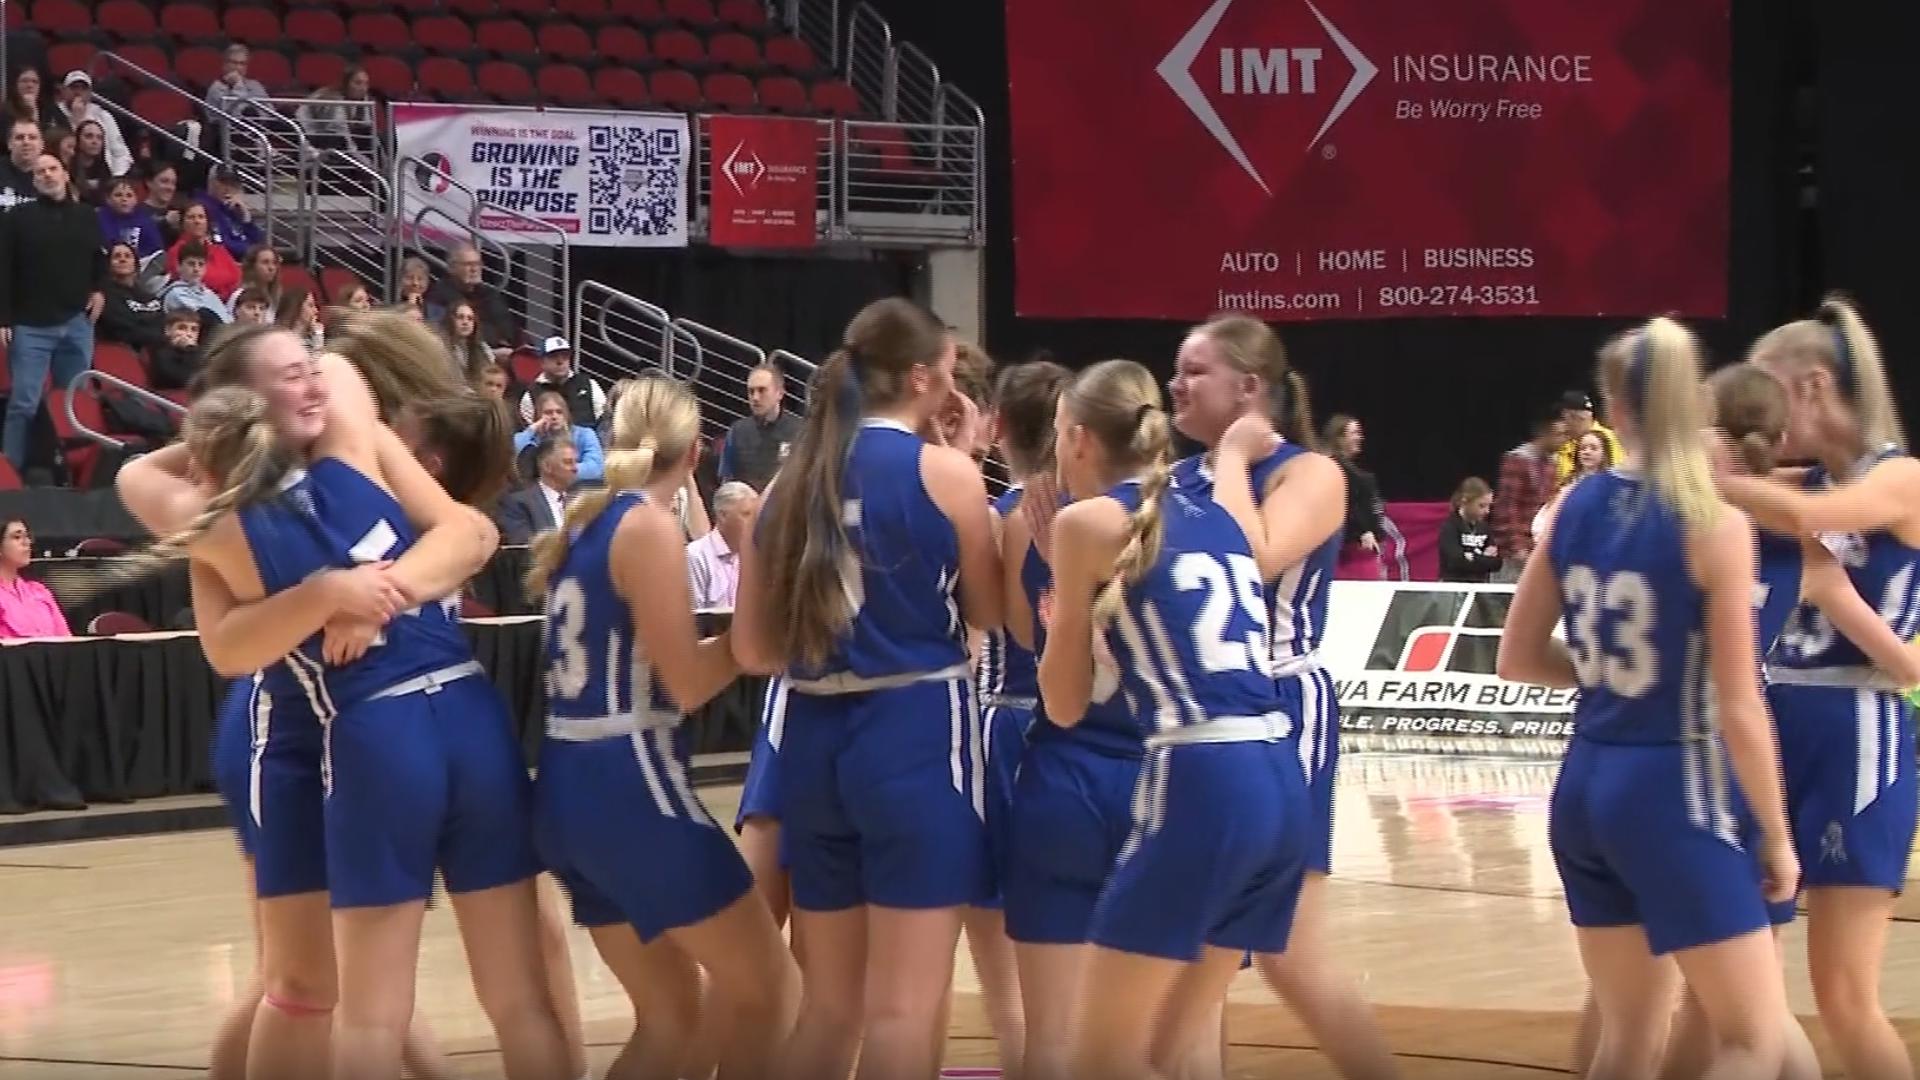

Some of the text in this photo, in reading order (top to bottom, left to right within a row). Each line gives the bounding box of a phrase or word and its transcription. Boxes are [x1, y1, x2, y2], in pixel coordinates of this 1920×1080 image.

[1220, 48, 1593, 94] IMT INSURANCE
[1395, 99, 1543, 122] Be Worry Free
[471, 141, 580, 167] GROWING
[491, 166, 563, 189] IS THE
[476, 188, 579, 214] PURPOSE
[1220, 248, 1534, 272] AUTO HOME BUSINESS
[1217, 285, 1539, 309] imtins.com 800-274-3531
[1169, 552, 1274, 678] 25
[544, 576, 590, 699] 3
[1563, 564, 1658, 698] 33
[1378, 681, 1472, 704] FARM
[1339, 714, 1375, 730] LE.
[1382, 716, 1504, 735] PROGRESS.
